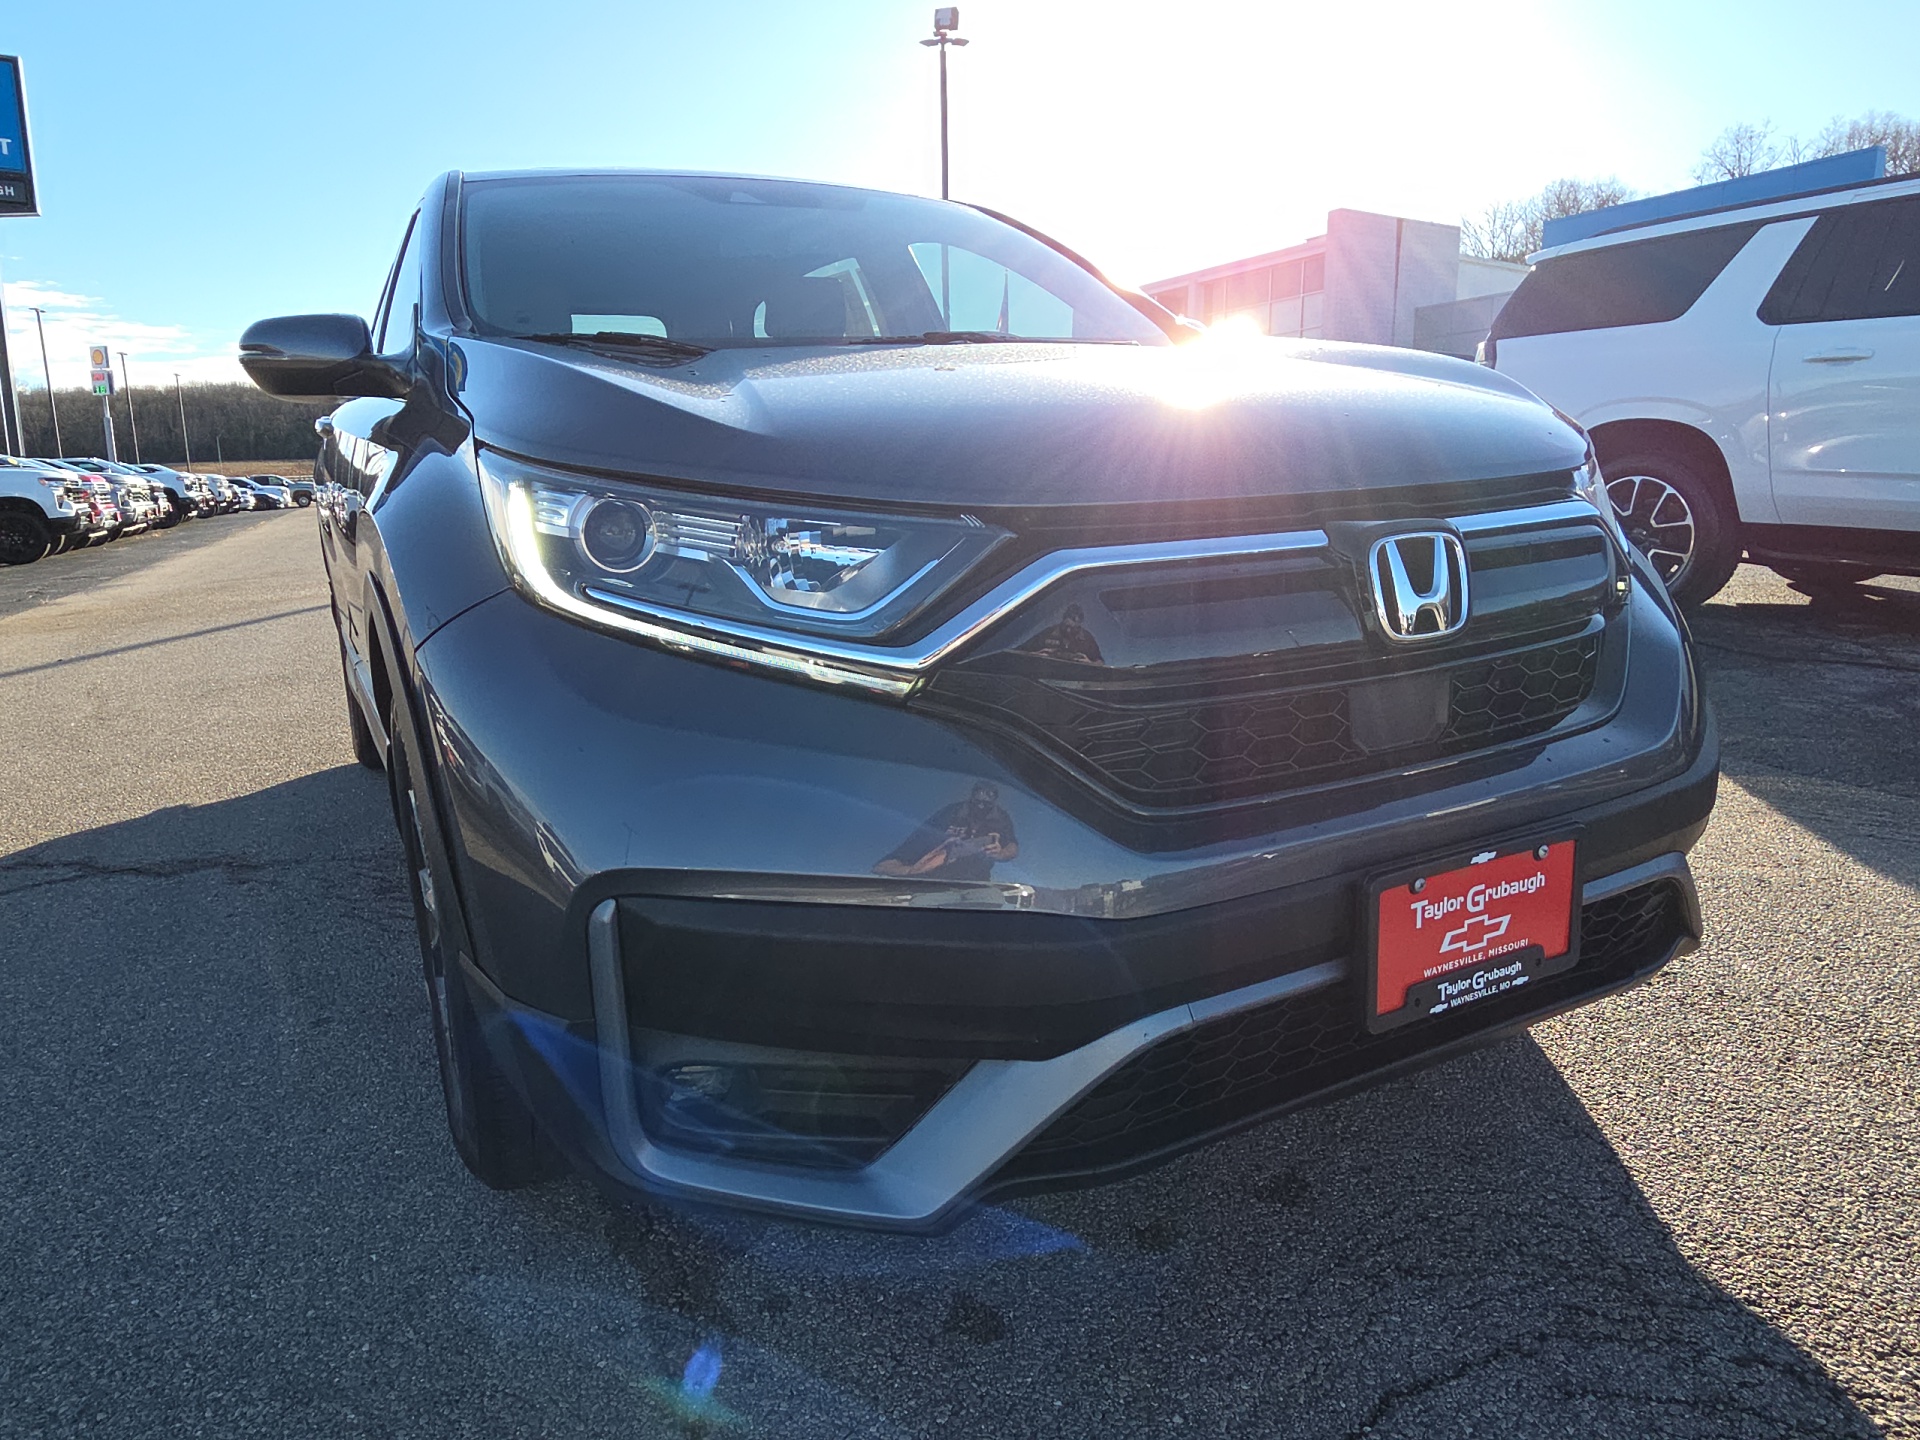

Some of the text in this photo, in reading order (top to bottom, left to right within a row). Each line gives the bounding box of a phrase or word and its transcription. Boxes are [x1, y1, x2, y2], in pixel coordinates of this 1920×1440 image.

[1411, 872, 1545, 929] Taylor Grubaugh
[1423, 938, 1529, 978] WAYNESVILLE, MISSOURI
[1437, 961, 1522, 1001] Taylor Grubaugh
[1450, 980, 1511, 1008] WAYNESVILLE, MO
